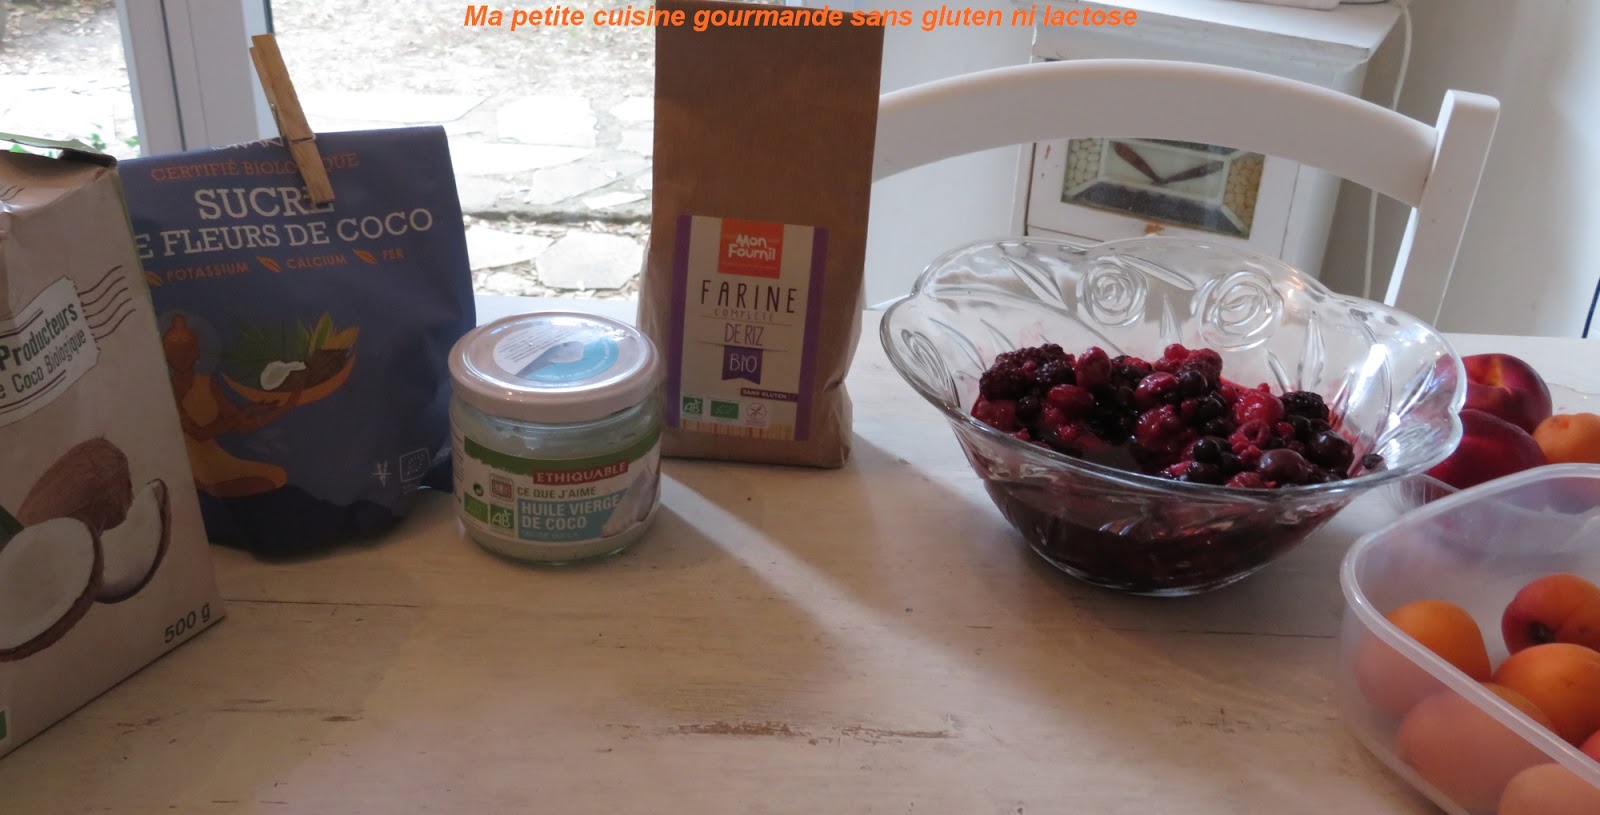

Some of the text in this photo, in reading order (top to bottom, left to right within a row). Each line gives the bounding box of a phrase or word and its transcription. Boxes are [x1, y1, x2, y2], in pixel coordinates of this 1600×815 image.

[243, 152, 359, 175] BIOLOQUE
[160, 223, 280, 257] FLEURS
[284, 222, 330, 247] DE
[336, 207, 433, 242] COCO
[736, 233, 767, 250] Mon
[728, 243, 776, 261] Fournil
[166, 262, 249, 281] POTASSIUM
[286, 255, 347, 270] CALCIUM
[701, 279, 798, 314] FARINE
[0, 303, 78, 371] Producteurs
[724, 323, 764, 347] DE RIZ
[11, 366, 44, 393] Coco
[44, 329, 86, 374] Biologique
[729, 353, 757, 374] BIO
[742, 389, 787, 400] SANS GLUTEN
[536, 462, 626, 483] ETHIQUABLE
[517, 486, 597, 499] CE QUE J'AIME
[521, 494, 620, 517] HUILE VIERGE
[522, 515, 587, 530] DE COCO
[165, 602, 210, 643] 500 g
